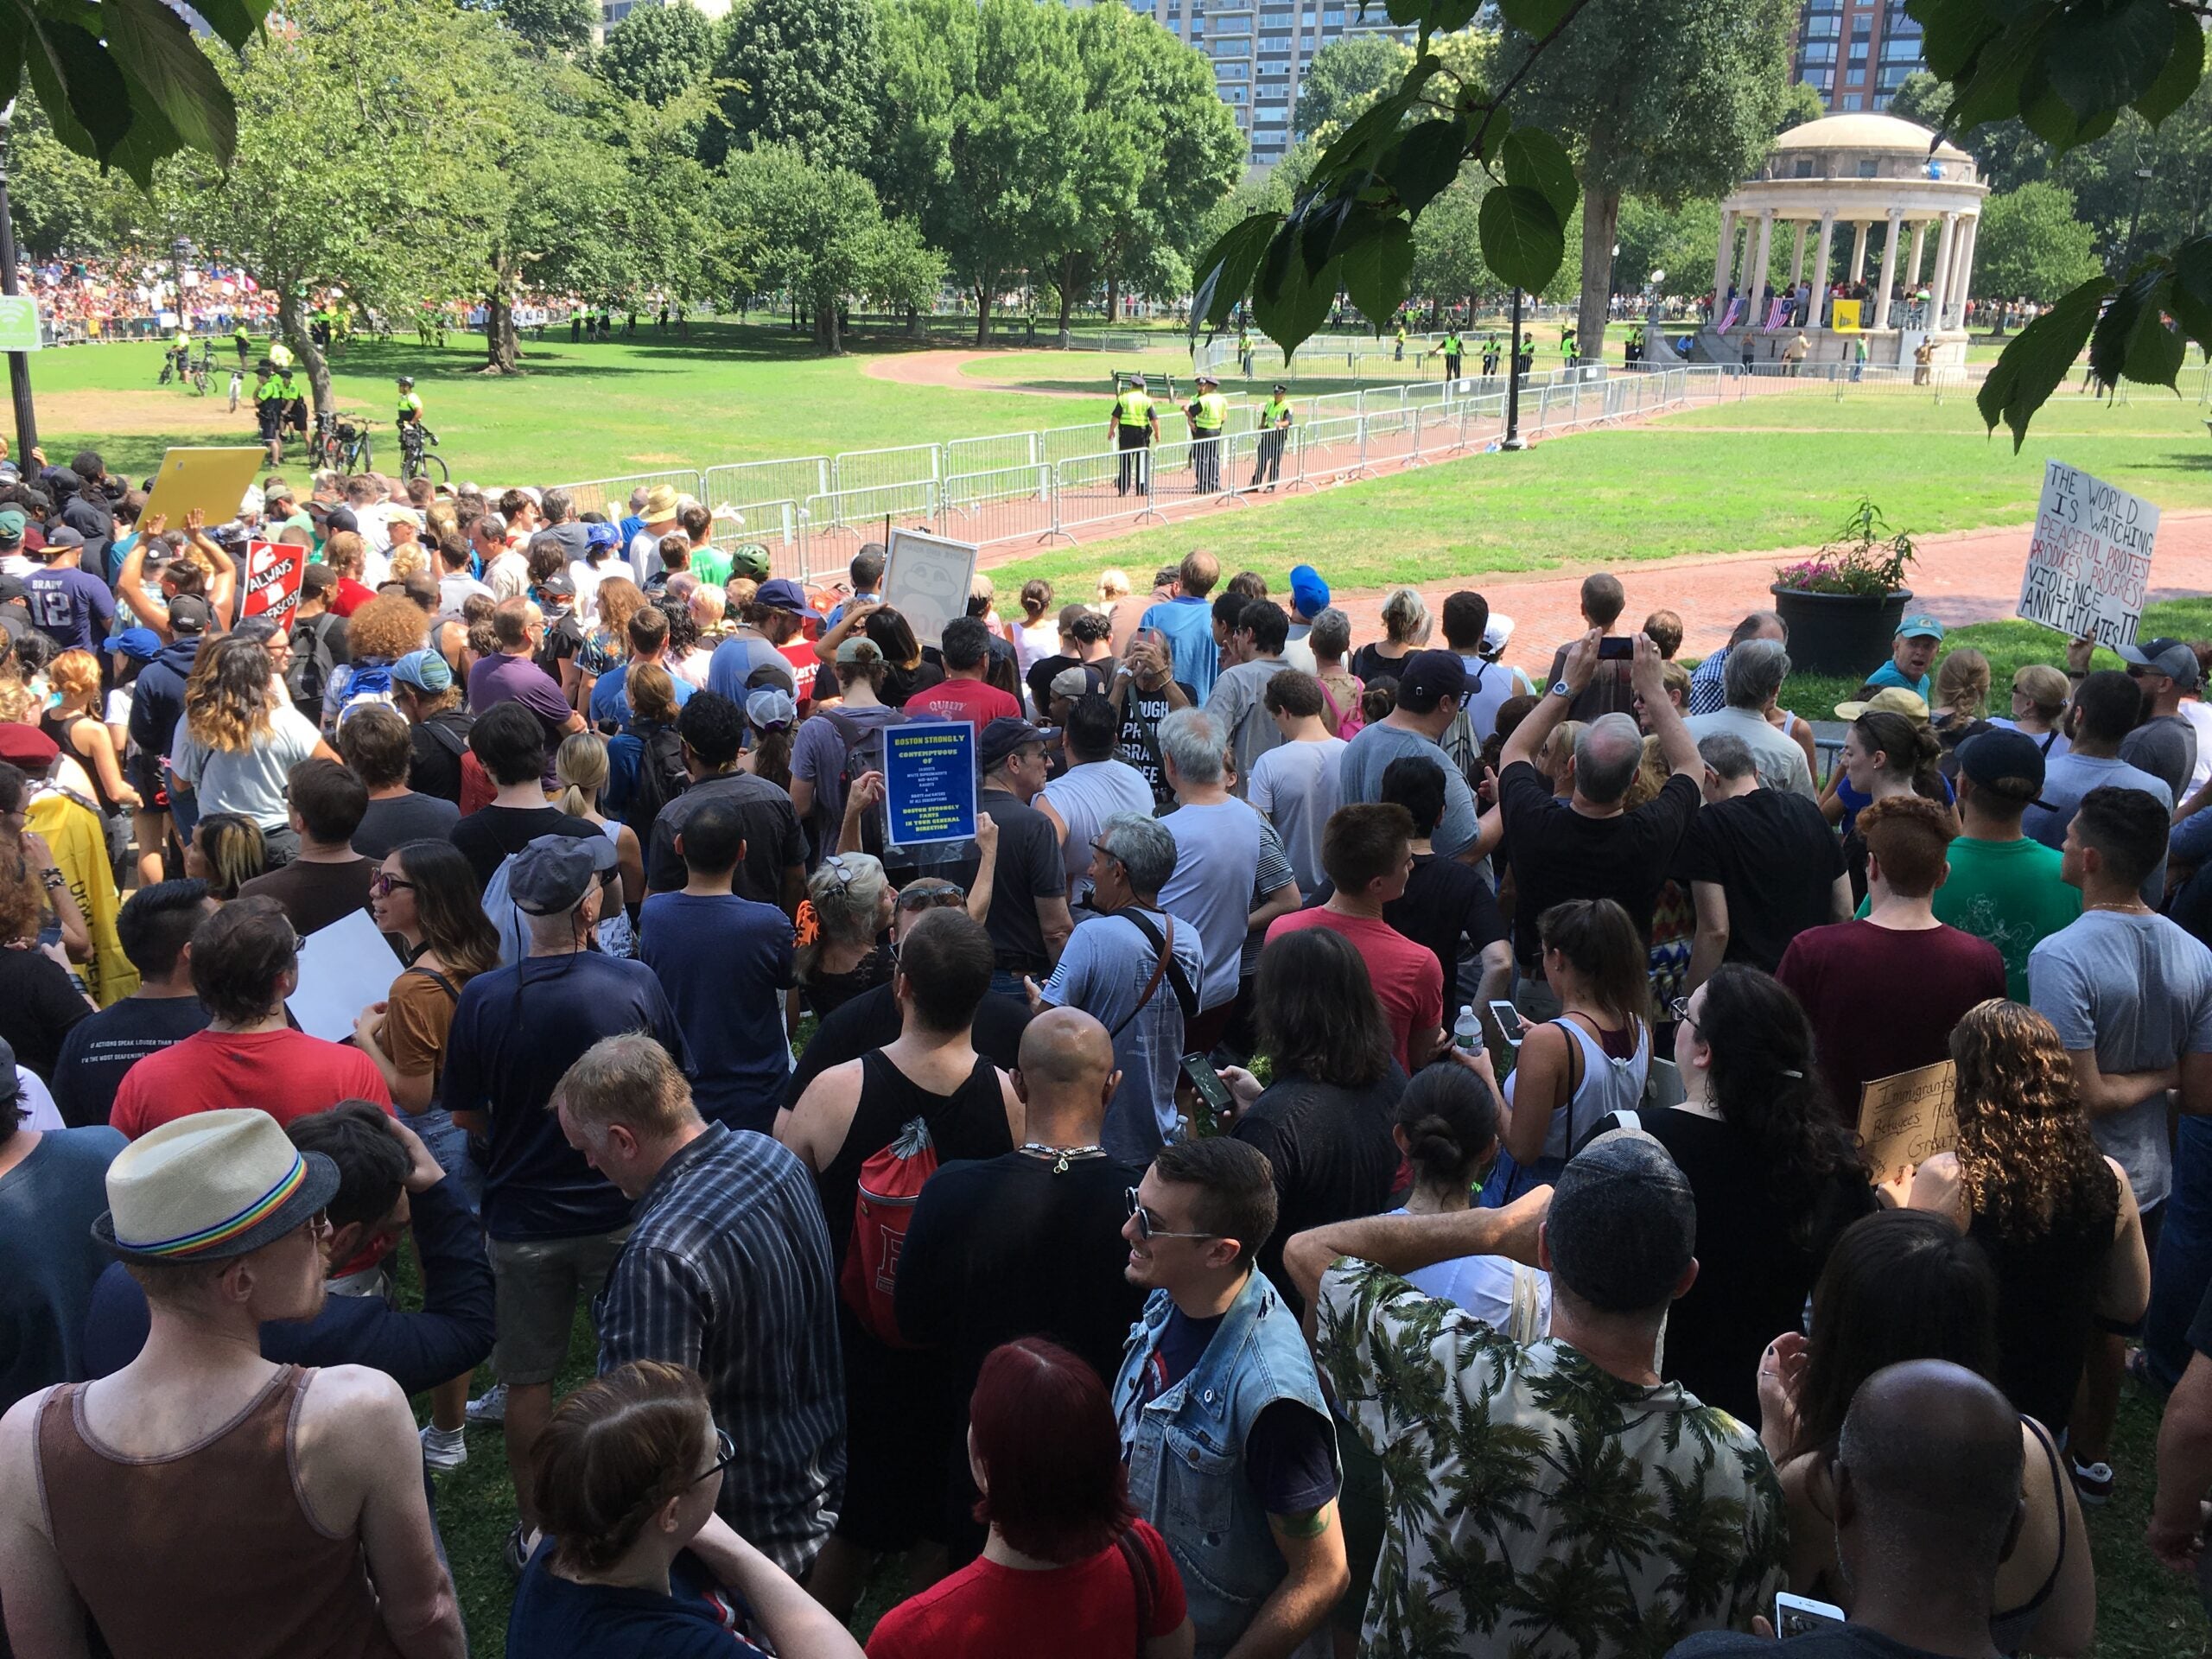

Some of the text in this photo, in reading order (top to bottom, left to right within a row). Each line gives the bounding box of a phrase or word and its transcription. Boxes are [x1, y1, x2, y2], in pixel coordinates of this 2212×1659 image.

[2050, 464, 2139, 524] THE WORLD
[2050, 493, 2154, 556] IS WATCHING
[2039, 513, 2152, 581] PEACEFUL PROTEST
[32, 580, 63, 589] BRADY
[249, 558, 293, 593] ALWAYS
[2029, 563, 2104, 613] VIOLENCE
[2030, 538, 2145, 611] PRODUCES PROGRESS
[31, 590, 72, 626] 12
[2021, 586, 2120, 646] ANNIHILATES
[894, 734, 965, 746] BOSTON STRONGLY
[899, 748, 957, 758] CONTEMPTUOUS
[915, 823, 948, 832] DIRECTION
[1874, 1077, 1955, 1109] Immigrants
